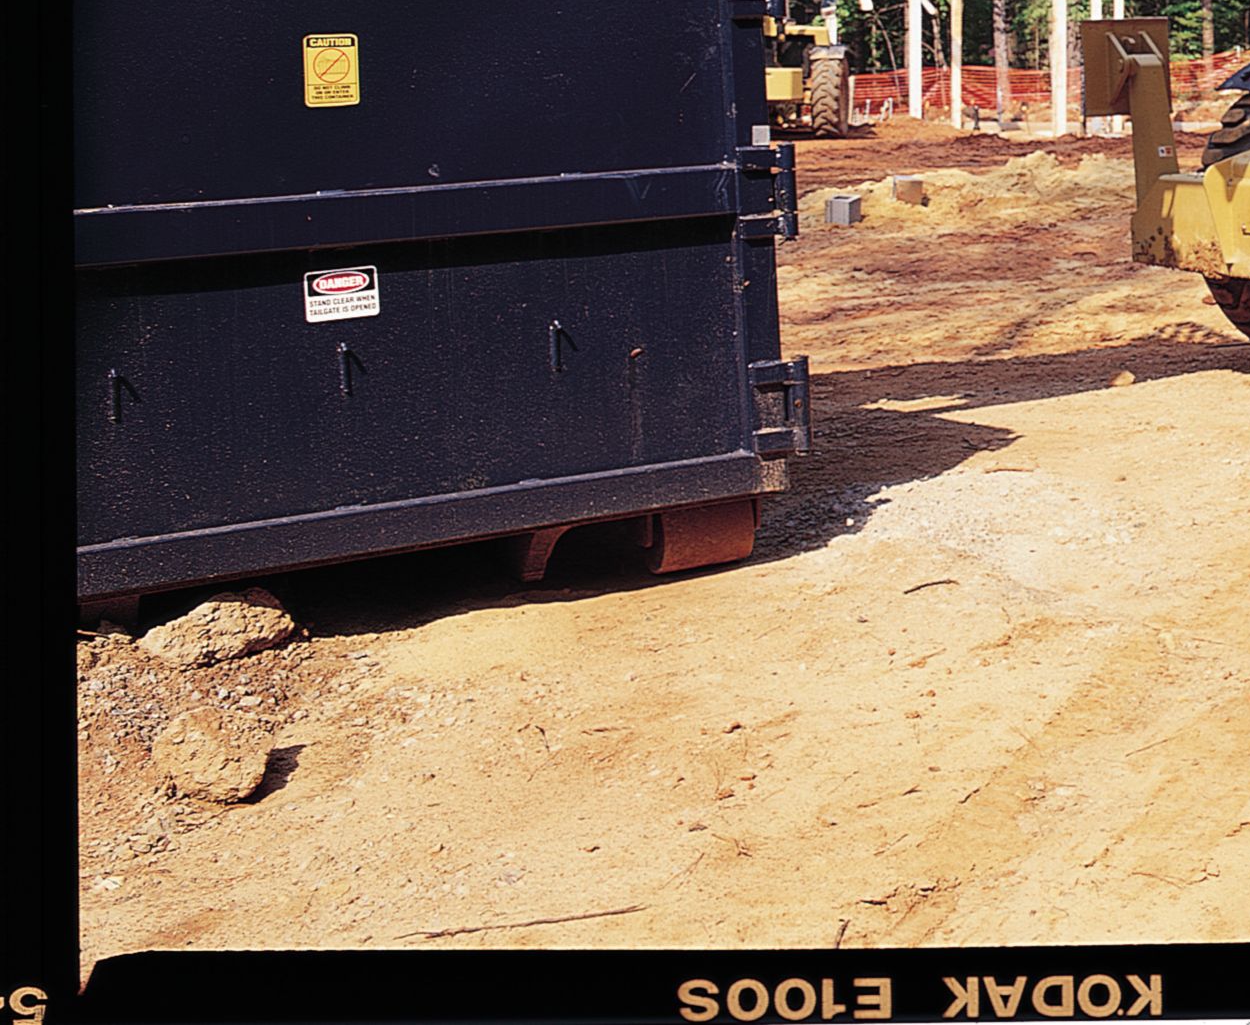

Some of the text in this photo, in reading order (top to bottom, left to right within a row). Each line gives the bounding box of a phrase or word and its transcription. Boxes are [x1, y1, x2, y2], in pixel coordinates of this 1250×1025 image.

[309, 38, 352, 46] CAUTION
[318, 276, 363, 289] DANGER
[309, 294, 375, 307] STAND CLEAR WHEN
[309, 307, 340, 316] TAILGATE
[351, 302, 376, 311] OPENED
[677, 974, 1162, 1022] KODAK E100S
